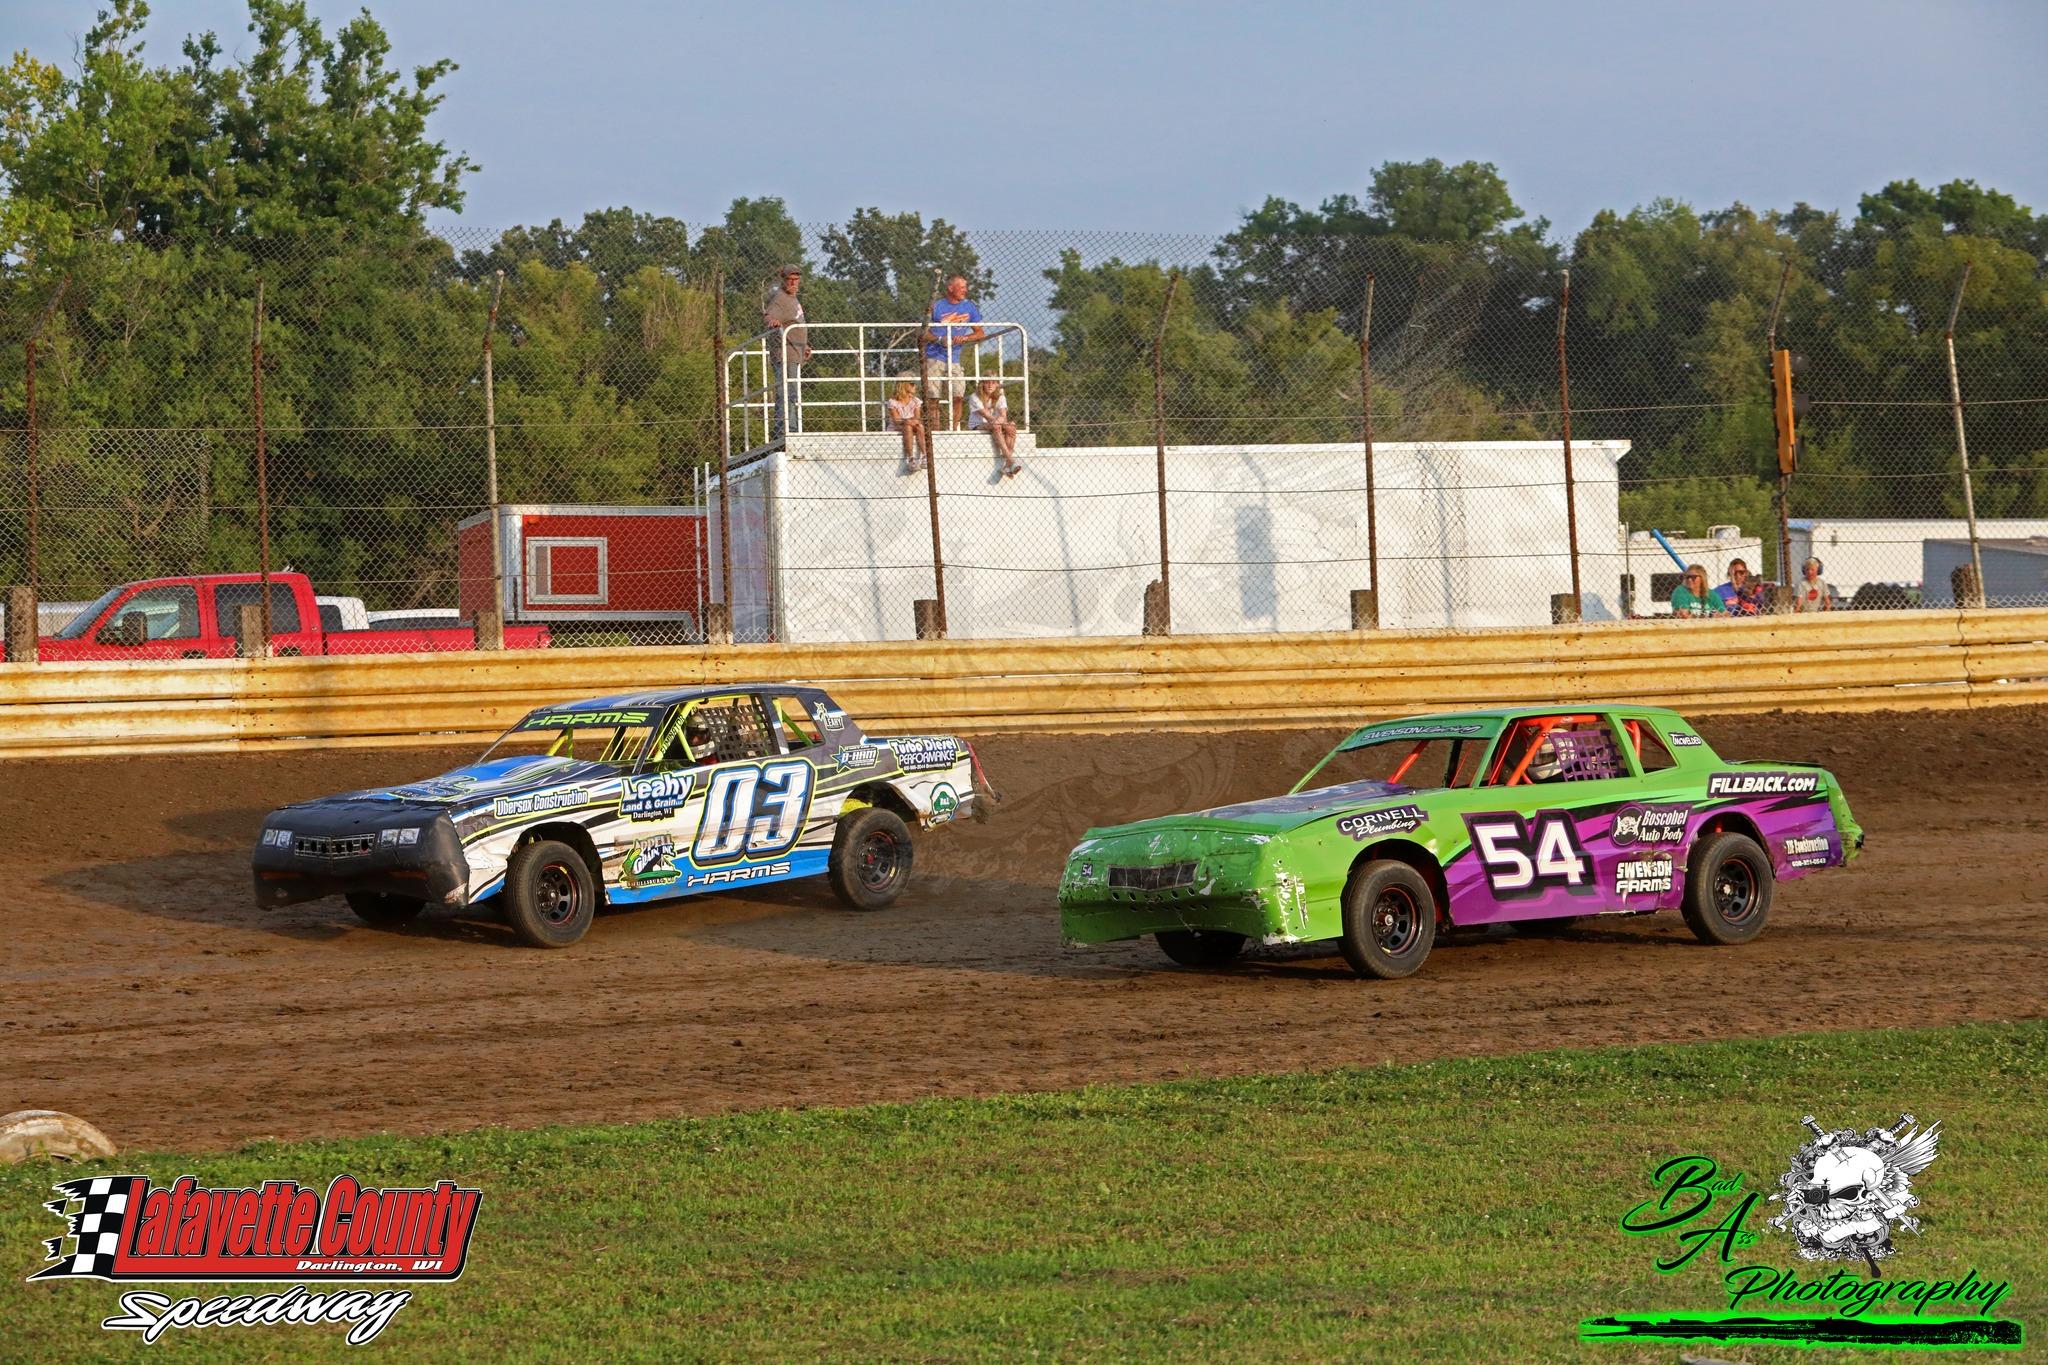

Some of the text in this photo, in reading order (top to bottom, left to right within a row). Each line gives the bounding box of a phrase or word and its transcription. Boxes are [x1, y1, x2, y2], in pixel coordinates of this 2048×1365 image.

[523, 711, 649, 729] HARMS
[1362, 726, 1423, 740] SWENSON
[890, 740, 923, 754] Turbo
[923, 738, 957, 751] Diesel
[899, 750, 955, 765] PERFORMANCE
[622, 774, 694, 800] Leahy
[1710, 776, 1816, 794] FILLBACK.COM
[496, 789, 589, 816] Ubersox Construction
[621, 801, 643, 812] Land
[645, 801, 653, 809] &
[654, 798, 676, 808] Grain
[695, 762, 811, 860] 03
[633, 810, 663, 819] Darlington,
[1340, 807, 1425, 832] CORNELL
[1641, 809, 1689, 826] Boscobel
[1356, 819, 1417, 838] Plumbing
[1638, 826, 1684, 843] Auto Body
[1475, 821, 1586, 890] 54
[687, 861, 791, 887] HARMS
[1082, 864, 1093, 876] 54
[1616, 860, 1673, 879] SWENSON
[1616, 877, 1672, 894] FARMS
